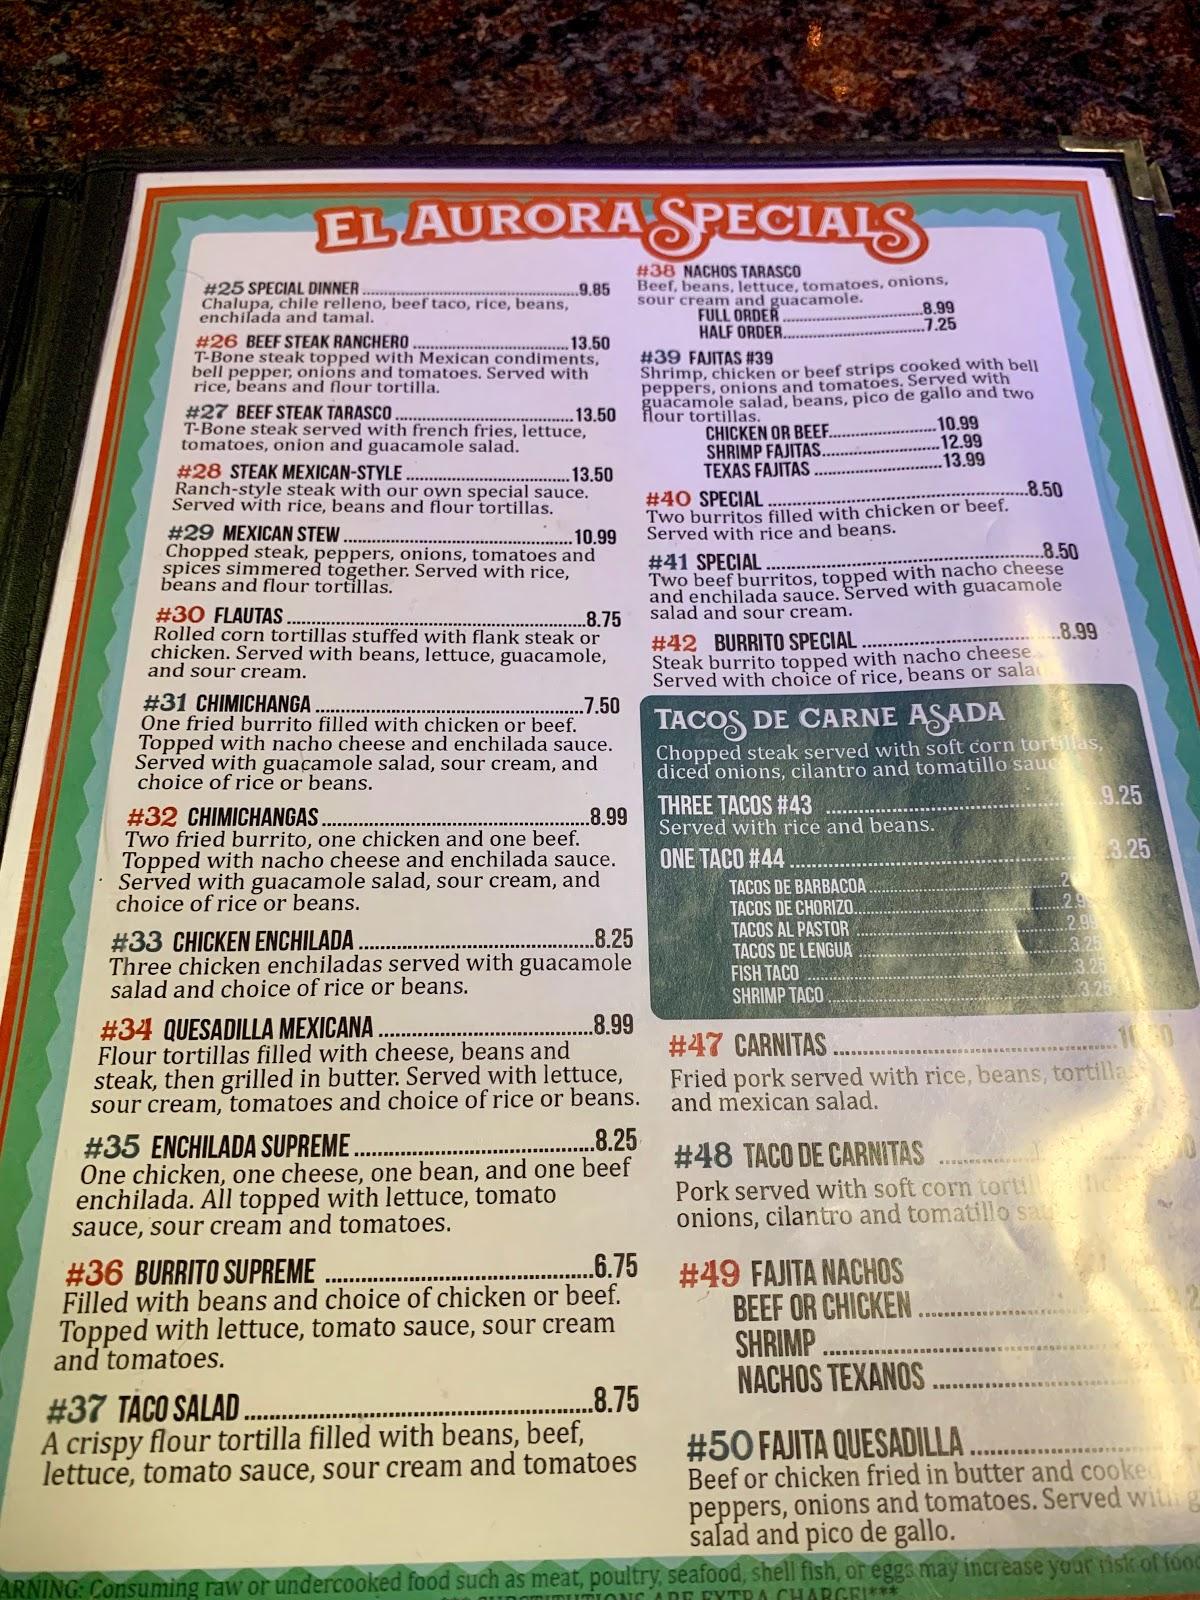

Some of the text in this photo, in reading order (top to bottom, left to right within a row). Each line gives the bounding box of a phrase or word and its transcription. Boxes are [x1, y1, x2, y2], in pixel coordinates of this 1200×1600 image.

[322, 198, 922, 260] EL AURORA SPECIALS
[637, 264, 801, 279] #38 NACHOS TARASCO
[203, 281, 610, 296] #25 SPECIAL DINNER 9.85
[637, 275, 948, 294] Beef, beans, lettuce, tomatoes, onions,
[202, 297, 569, 313] Chalupa, chile relleno, beef taco, rice, beans,
[637, 292, 863, 308] sour cream and guacamole.
[698, 300, 955, 322] FULL ORDER 8.99
[199, 311, 374, 323] enchilada and tamal.
[699, 316, 957, 339] HALF ORDER 7.25
[196, 334, 610, 350] #26 BEEF STEAK RANCHERO 13.50
[640, 349, 773, 366] #39 FAJITAS #39
[706, 415, 979, 441] CHICKEN OR BEEF 10.99
[707, 433, 983, 460] SHRIMP FAJITAS 12.99
[646, 480, 1063, 507] #40 SPECIAL 8.50
[168, 524, 616, 545] #29 MEXICAN STEW 10.99
[648, 542, 1079, 571] #41 SPECIAL 8.50
[156, 605, 621, 627] #30 FLAUTAS 8.75
[652, 622, 1098, 652] #42 BURRITO SPECIAL 8.99
[143, 693, 620, 714] #31 CHIMICHANGA 7.50
[654, 702, 1006, 742] TACOS DE CARNE ASADA
[657, 785, 1143, 817] THREE TACOS #43 9.25
[659, 816, 935, 839] Served with rice and beans.
[660, 838, 1150, 869] ONE TACO #44 3.25
[729, 877, 867, 896] TACOS DE BARBACOA
[730, 899, 854, 916] TACOS DE CHORIZO
[731, 920, 850, 939] TACOS AL PASTOR
[732, 942, 776, 960] TACOS
[779, 942, 797, 959] DE
[799, 941, 853, 959] LENGUA
[731, 963, 762, 982] FISH
[764, 964, 799, 981] TACO
[732, 986, 824, 1006] SHRIMP TACO
[100, 1013, 633, 1042] #34 QUESADILLA MEXICANA 8.99
[669, 1032, 827, 1057] #47 CARNITAS
[674, 1140, 925, 1169] #48 TACO DE CARNITAS
[679, 1257, 904, 1289] #49 FAJITA NACHOS
[733, 1290, 912, 1322] BEEF OR CHICKEN
[736, 1328, 816, 1358] SHRIMP
[738, 1361, 925, 1394] NACHOS TEXANOS
[46, 1385, 639, 1424] #37 TACO SALAD 8.75
[687, 1426, 964, 1462] #50 FAJITA QUESADILLA
[90, 1551, 1161, 1600] Consuming raw or undercooked food such as meat, poultry, seafood, shell fish, or eggs may increase your risk of
